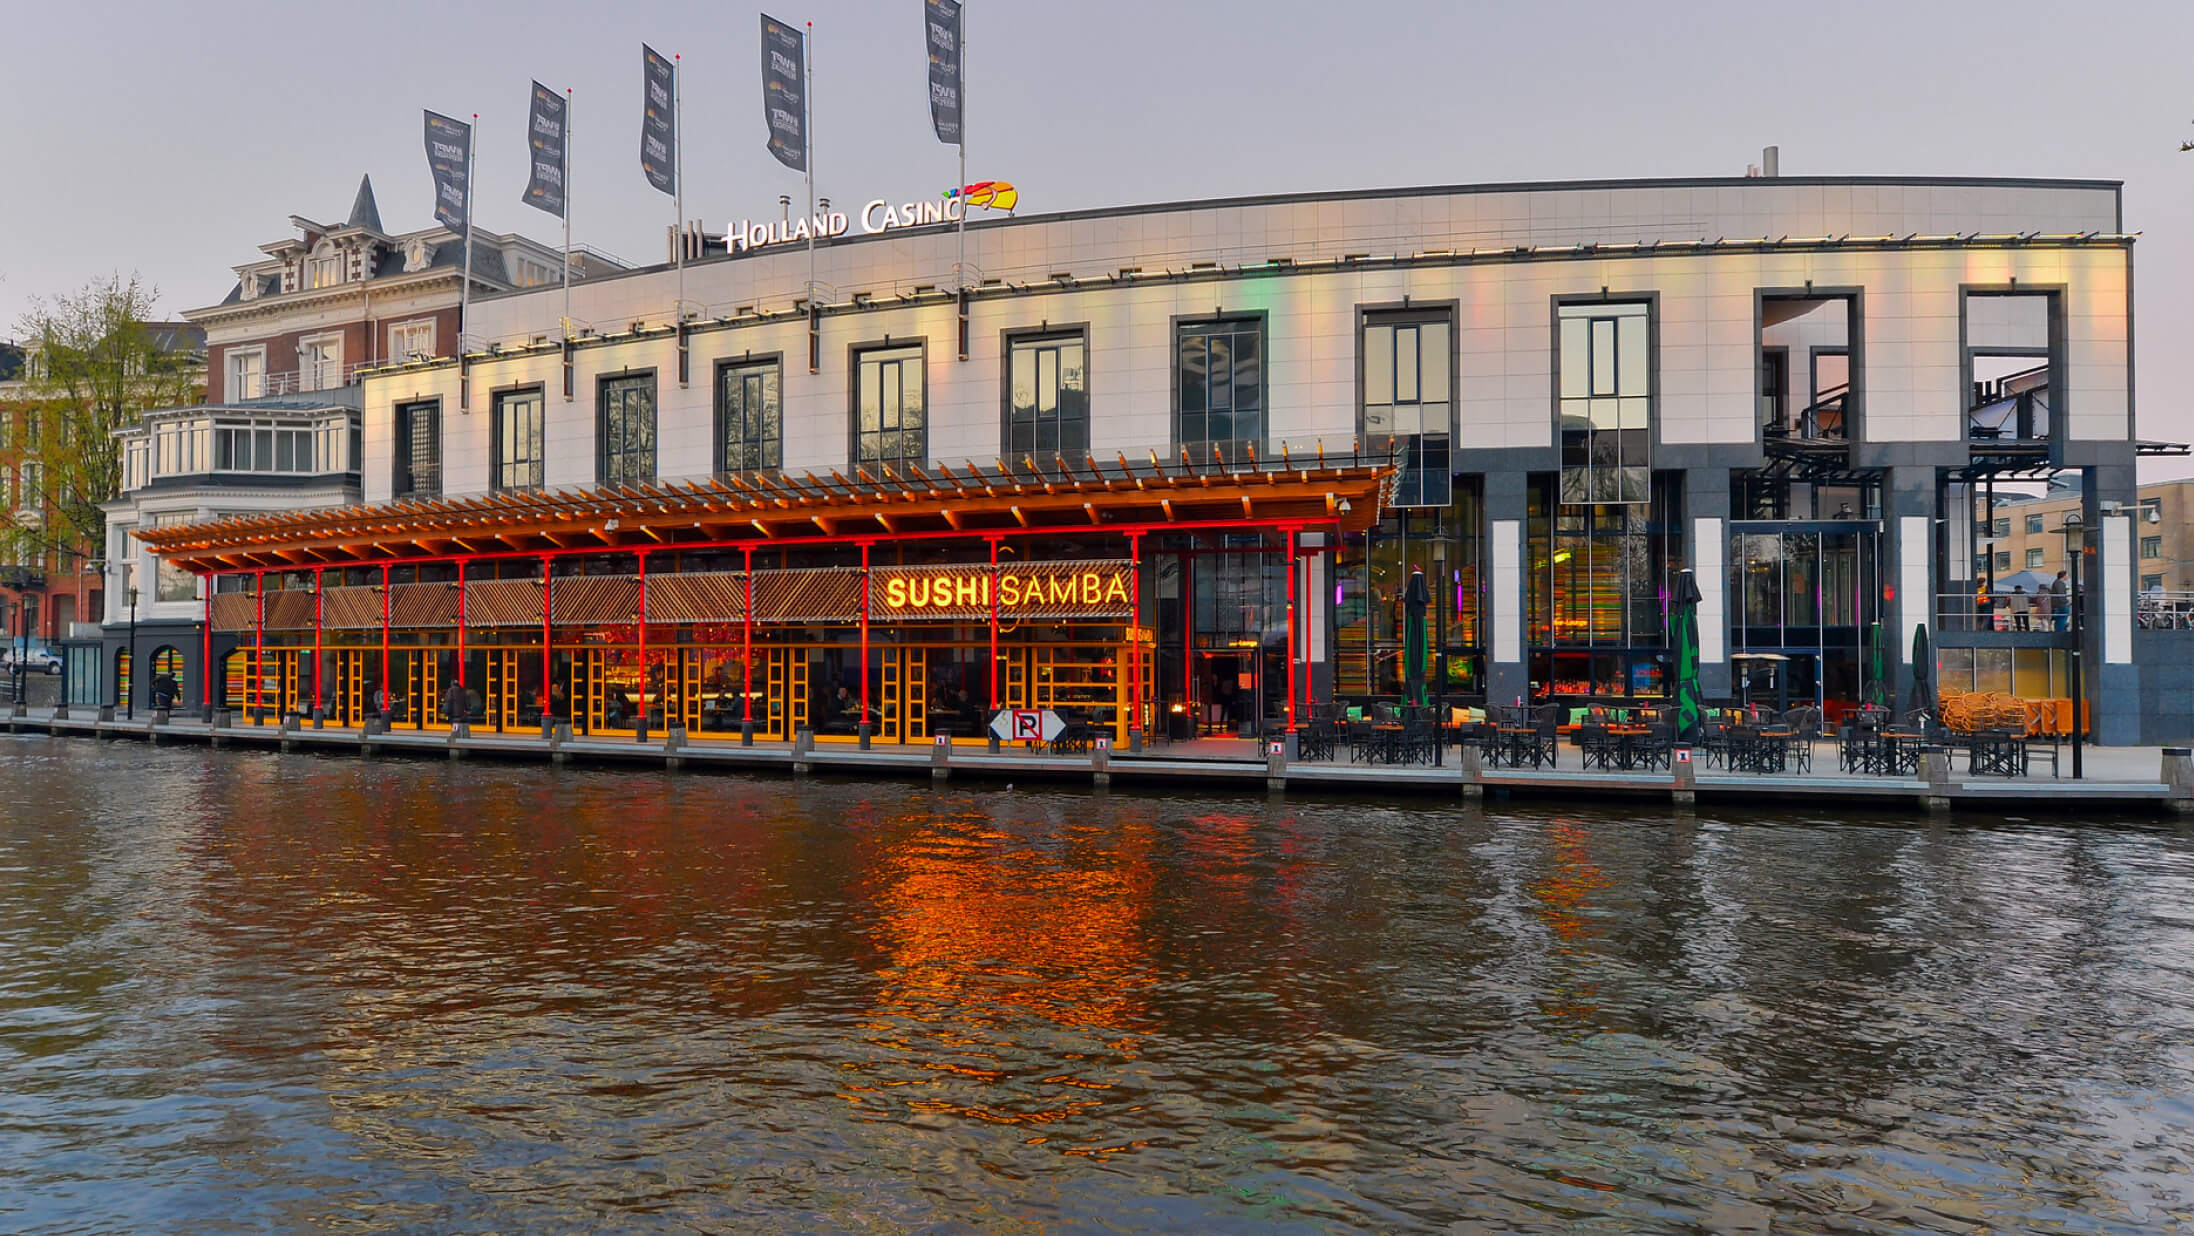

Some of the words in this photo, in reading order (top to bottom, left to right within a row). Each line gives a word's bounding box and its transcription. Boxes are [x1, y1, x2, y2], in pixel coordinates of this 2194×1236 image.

[721, 212, 848, 254] HOLLAND
[887, 575, 989, 608] SUSHI
[1000, 572, 1129, 606] SAMBA
[1019, 715, 1037, 736] P
